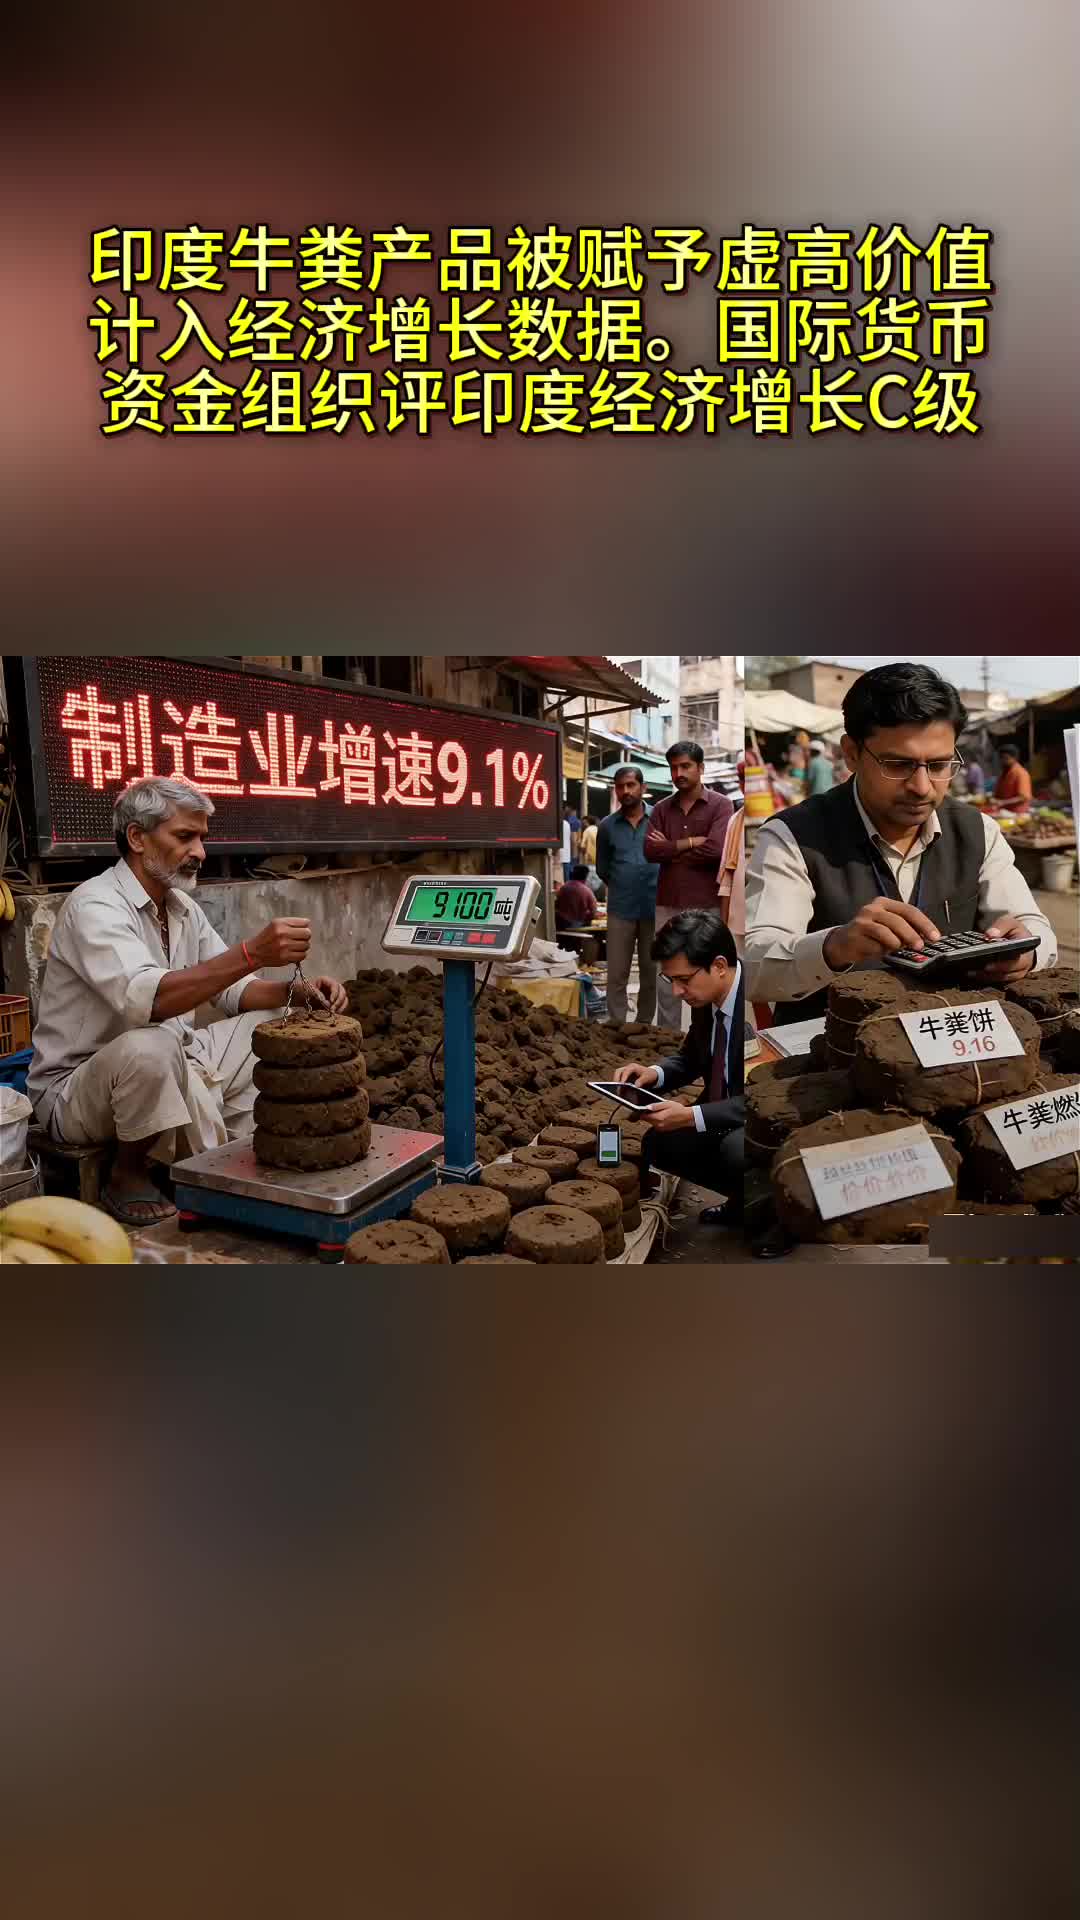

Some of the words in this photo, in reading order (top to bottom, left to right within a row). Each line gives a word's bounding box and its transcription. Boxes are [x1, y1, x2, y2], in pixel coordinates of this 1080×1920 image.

[61, 685, 549, 810] 制造业增速9.1%
[919, 1007, 996, 1040] 牛粪饼
[953, 1035, 996, 1057] 9.16
[1003, 1091, 1080, 1135] 牛粪燃
